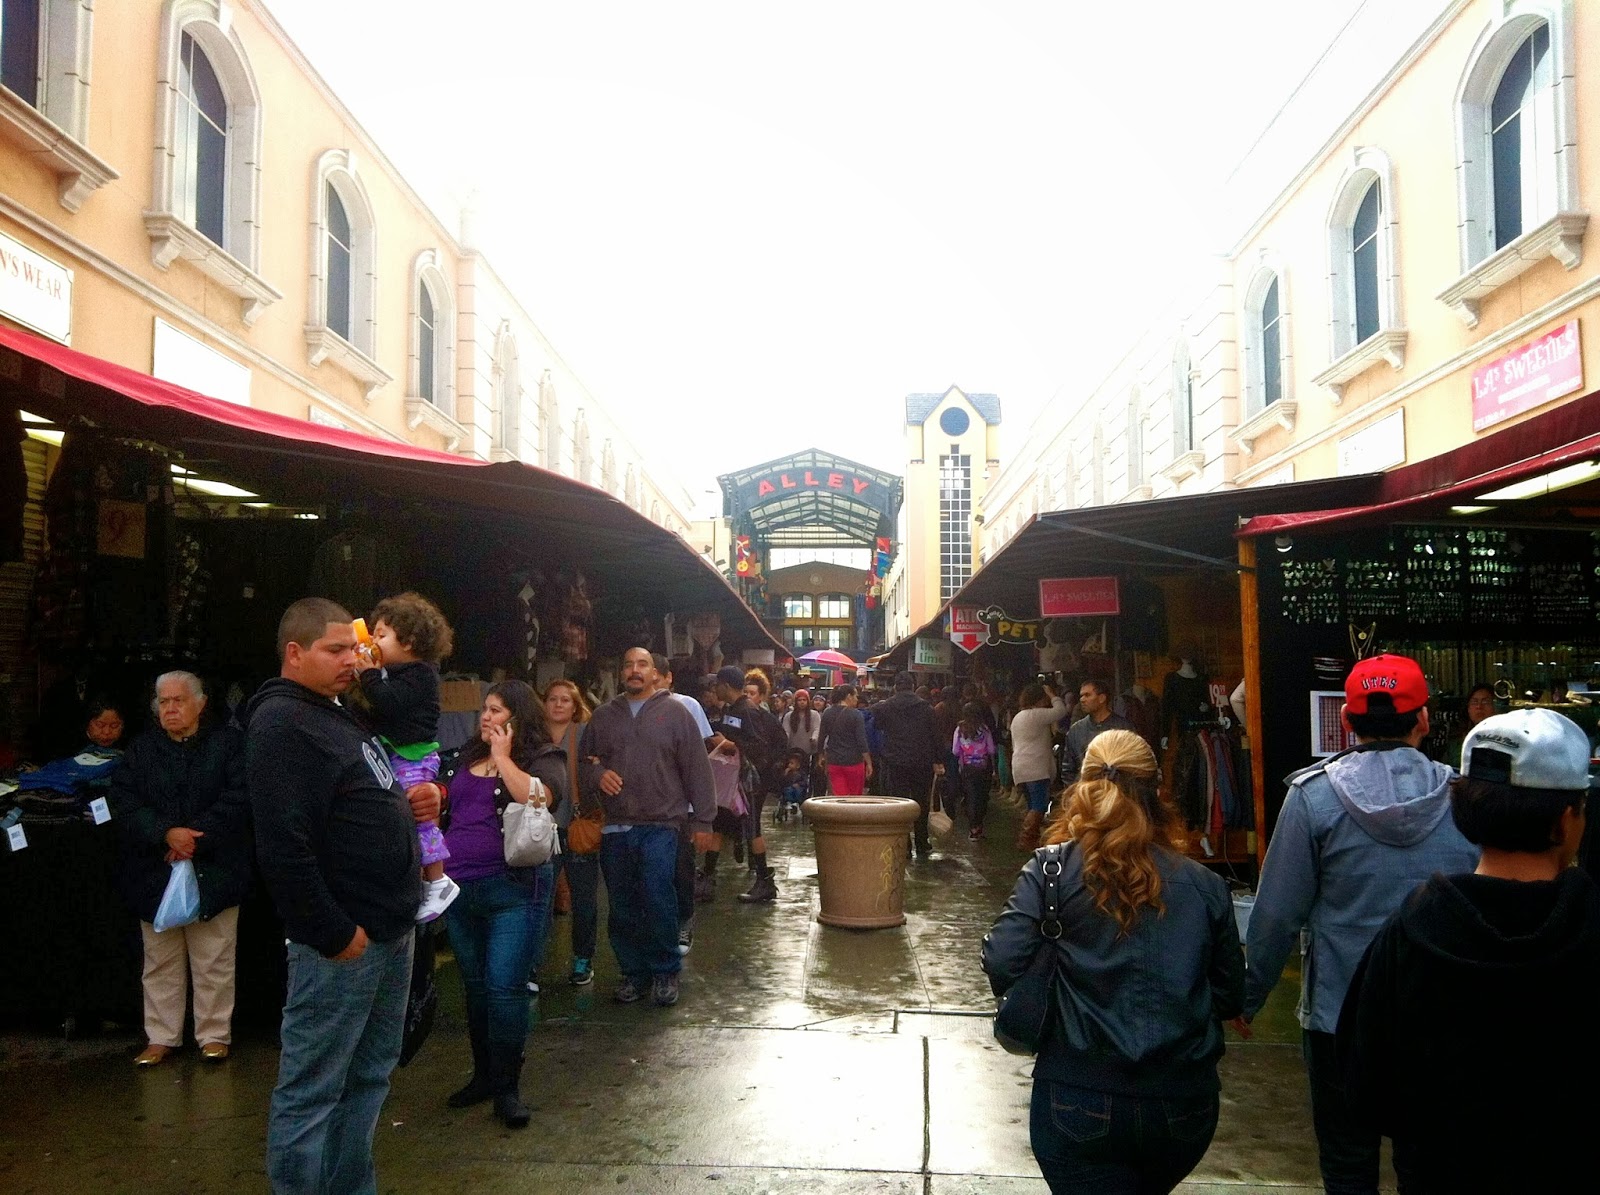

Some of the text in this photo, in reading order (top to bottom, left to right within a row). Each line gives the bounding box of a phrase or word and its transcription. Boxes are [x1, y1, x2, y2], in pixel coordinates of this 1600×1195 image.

[23, 260, 61, 300] WEAR
[1503, 328, 1576, 384] SWEETIES
[758, 470, 870, 497] ALLEY
[997, 620, 1038, 639] PET
[1361, 676, 1401, 691] UTES
